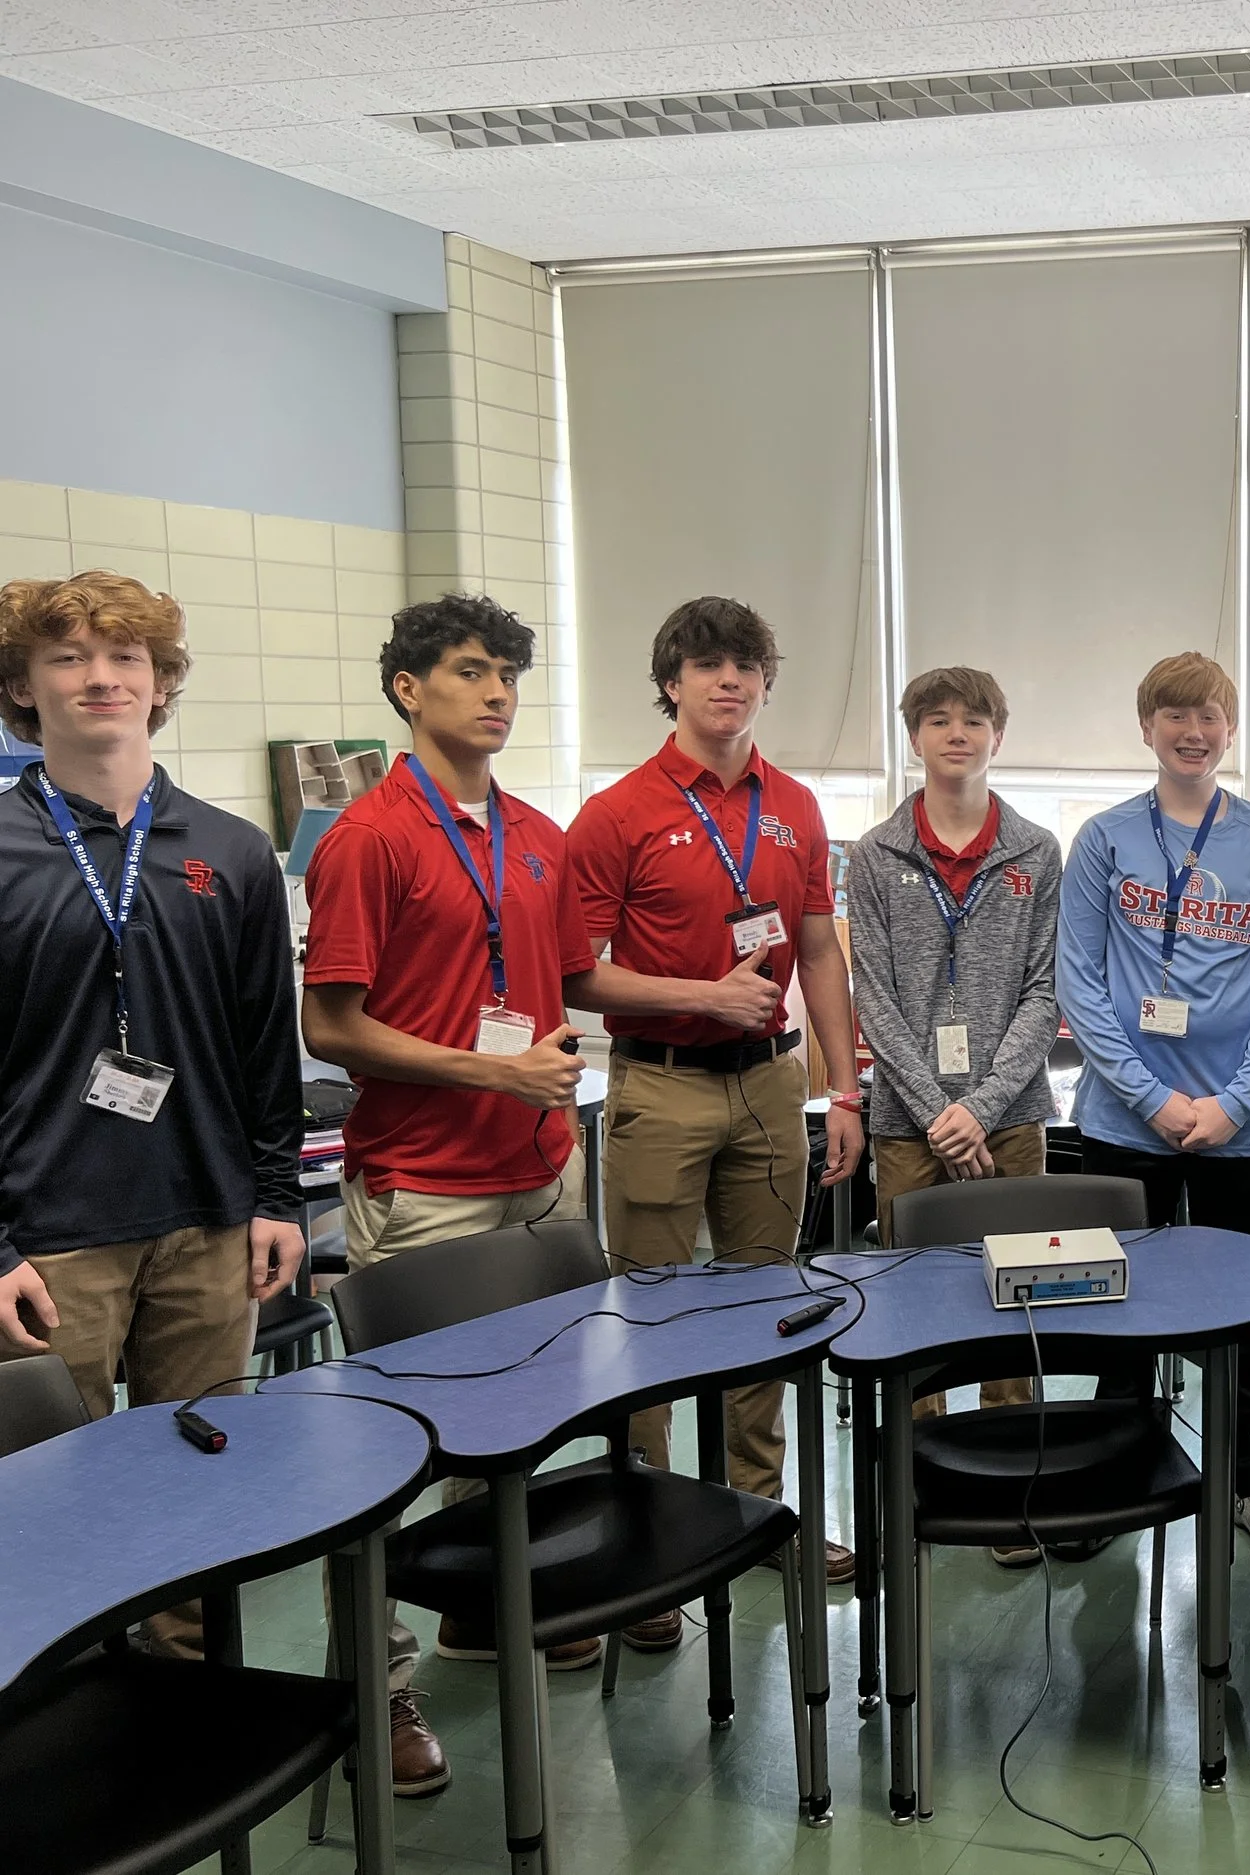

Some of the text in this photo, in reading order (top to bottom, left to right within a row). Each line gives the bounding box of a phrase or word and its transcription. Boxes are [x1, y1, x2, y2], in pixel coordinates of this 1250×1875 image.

[758, 815, 797, 848] SR
[67, 830, 116, 921] St. Rita High School
[120, 830, 145, 922] St. Rita High School
[184, 859, 216, 896] SR
[1003, 863, 1035, 896] SR
[928, 876, 940, 893] High
[936, 892, 951, 918] School
[963, 895, 975, 909] Rita
[971, 880, 984, 896] High
[1125, 912, 1193, 933] MUSTAGS
